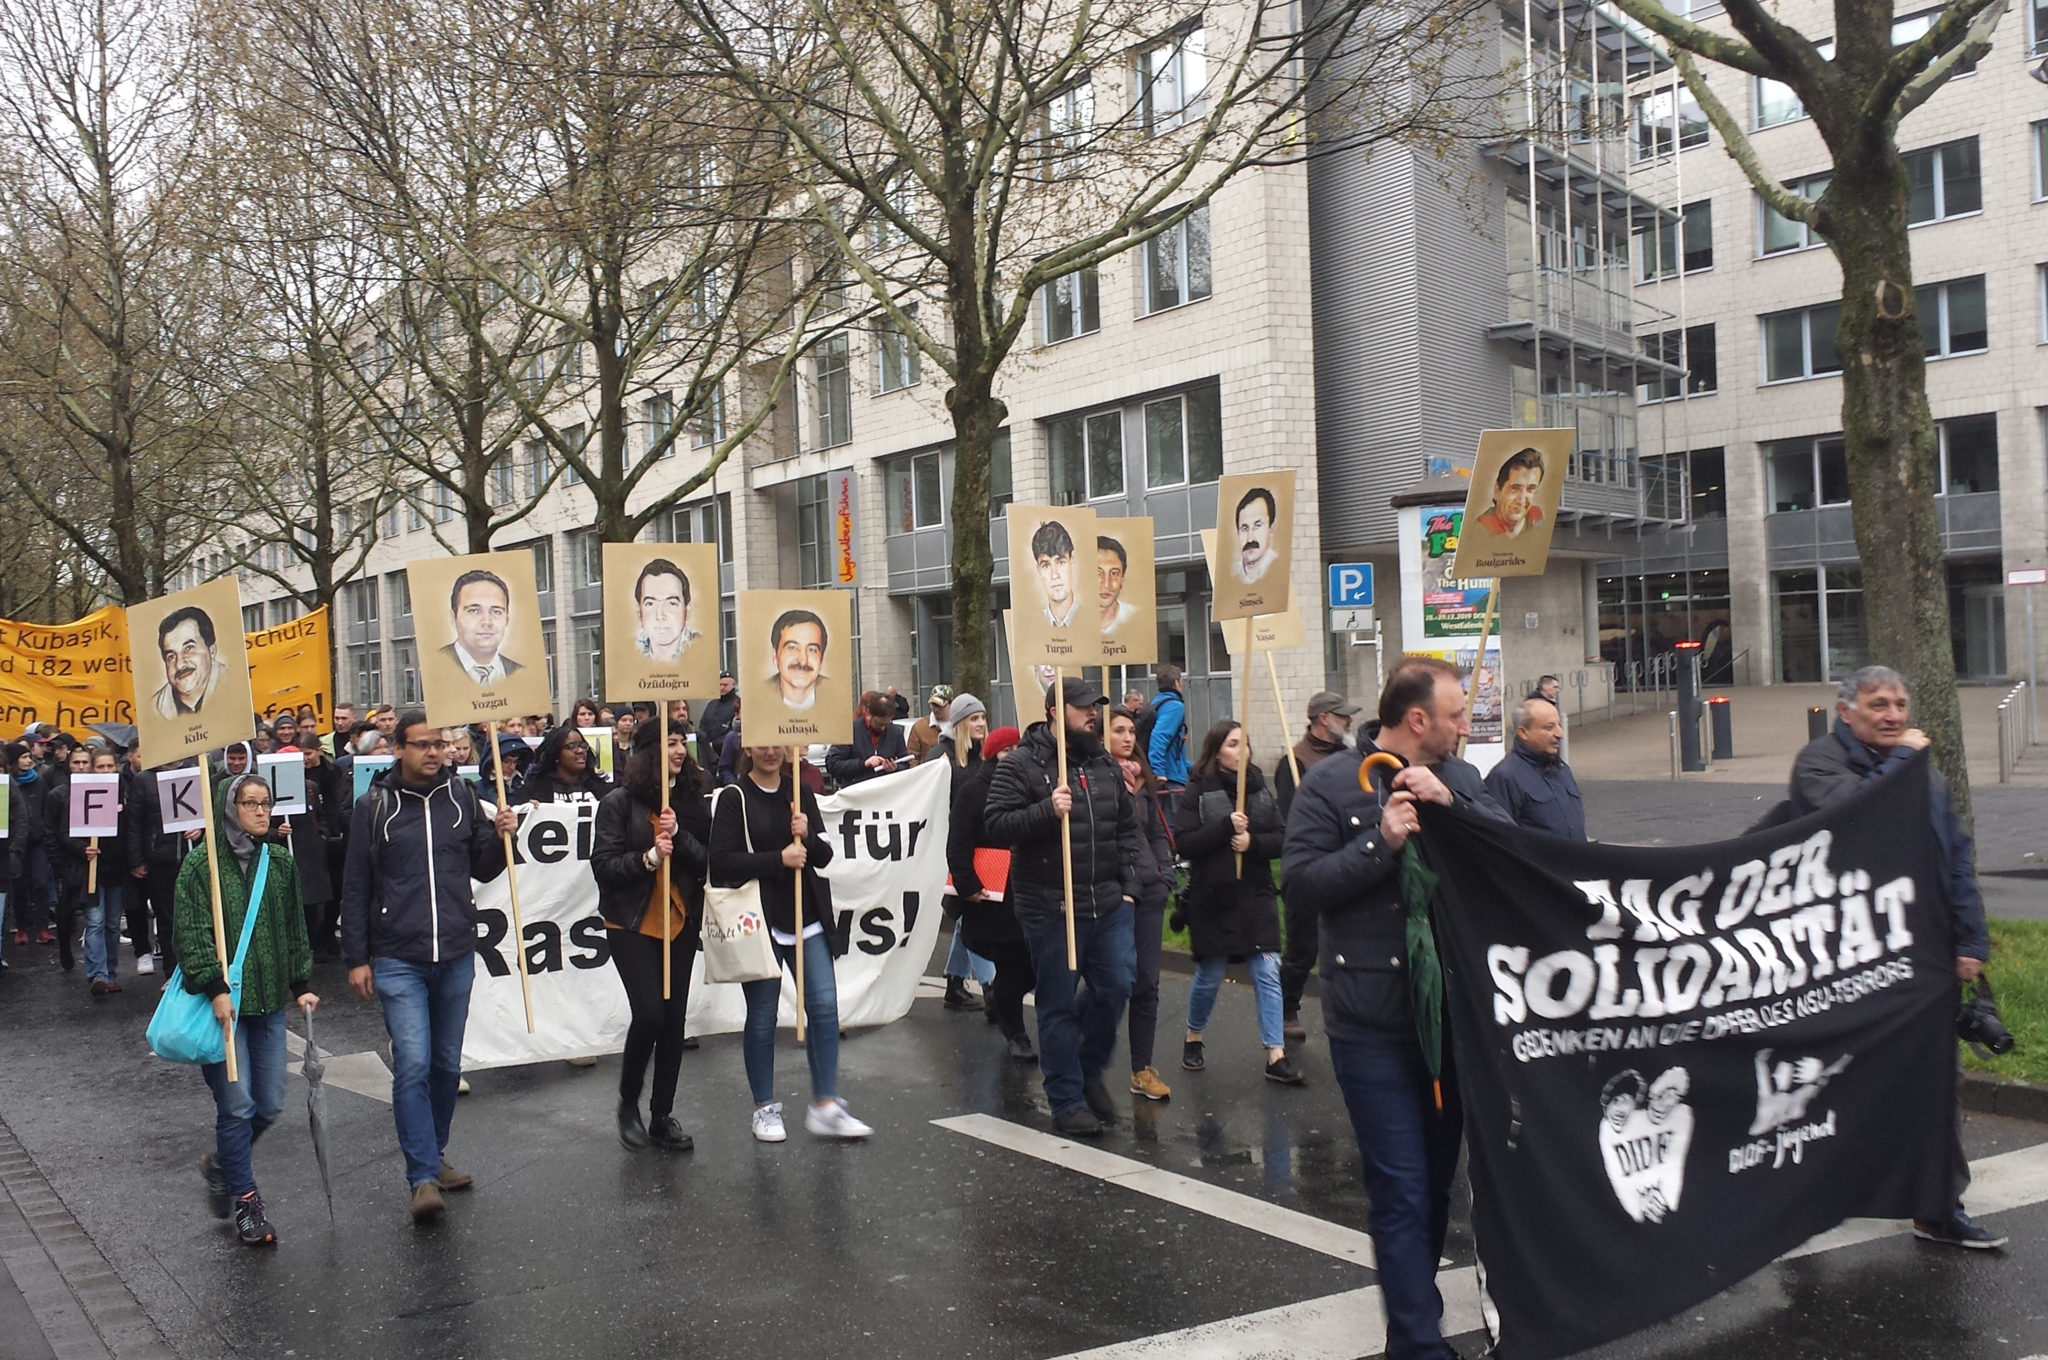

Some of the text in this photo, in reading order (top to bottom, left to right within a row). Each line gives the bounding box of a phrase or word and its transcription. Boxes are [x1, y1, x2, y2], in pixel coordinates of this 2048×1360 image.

[1340, 569, 1364, 602] P
[1437, 578, 1496, 590] The Hum
[1045, 644, 1073, 655] Turgut
[1101, 645, 1127, 656] öprü
[26, 655, 73, 677] 182
[638, 679, 690, 690] Özüdoğru
[471, 698, 508, 710] Yozgat
[184, 731, 209, 745] Kılıç
[778, 724, 818, 736] Kubaşık
[272, 765, 294, 802] L
[84, 789, 108, 825] F
[171, 780, 197, 819] K
[839, 810, 928, 862] für
[1573, 829, 1838, 942] TAG DER
[1486, 868, 1915, 1027] SOLIDARITÄT
[1624, 1025, 1659, 1050] AN
[1659, 1020, 1702, 1045] DIE
[1760, 999, 1796, 1028] DES
